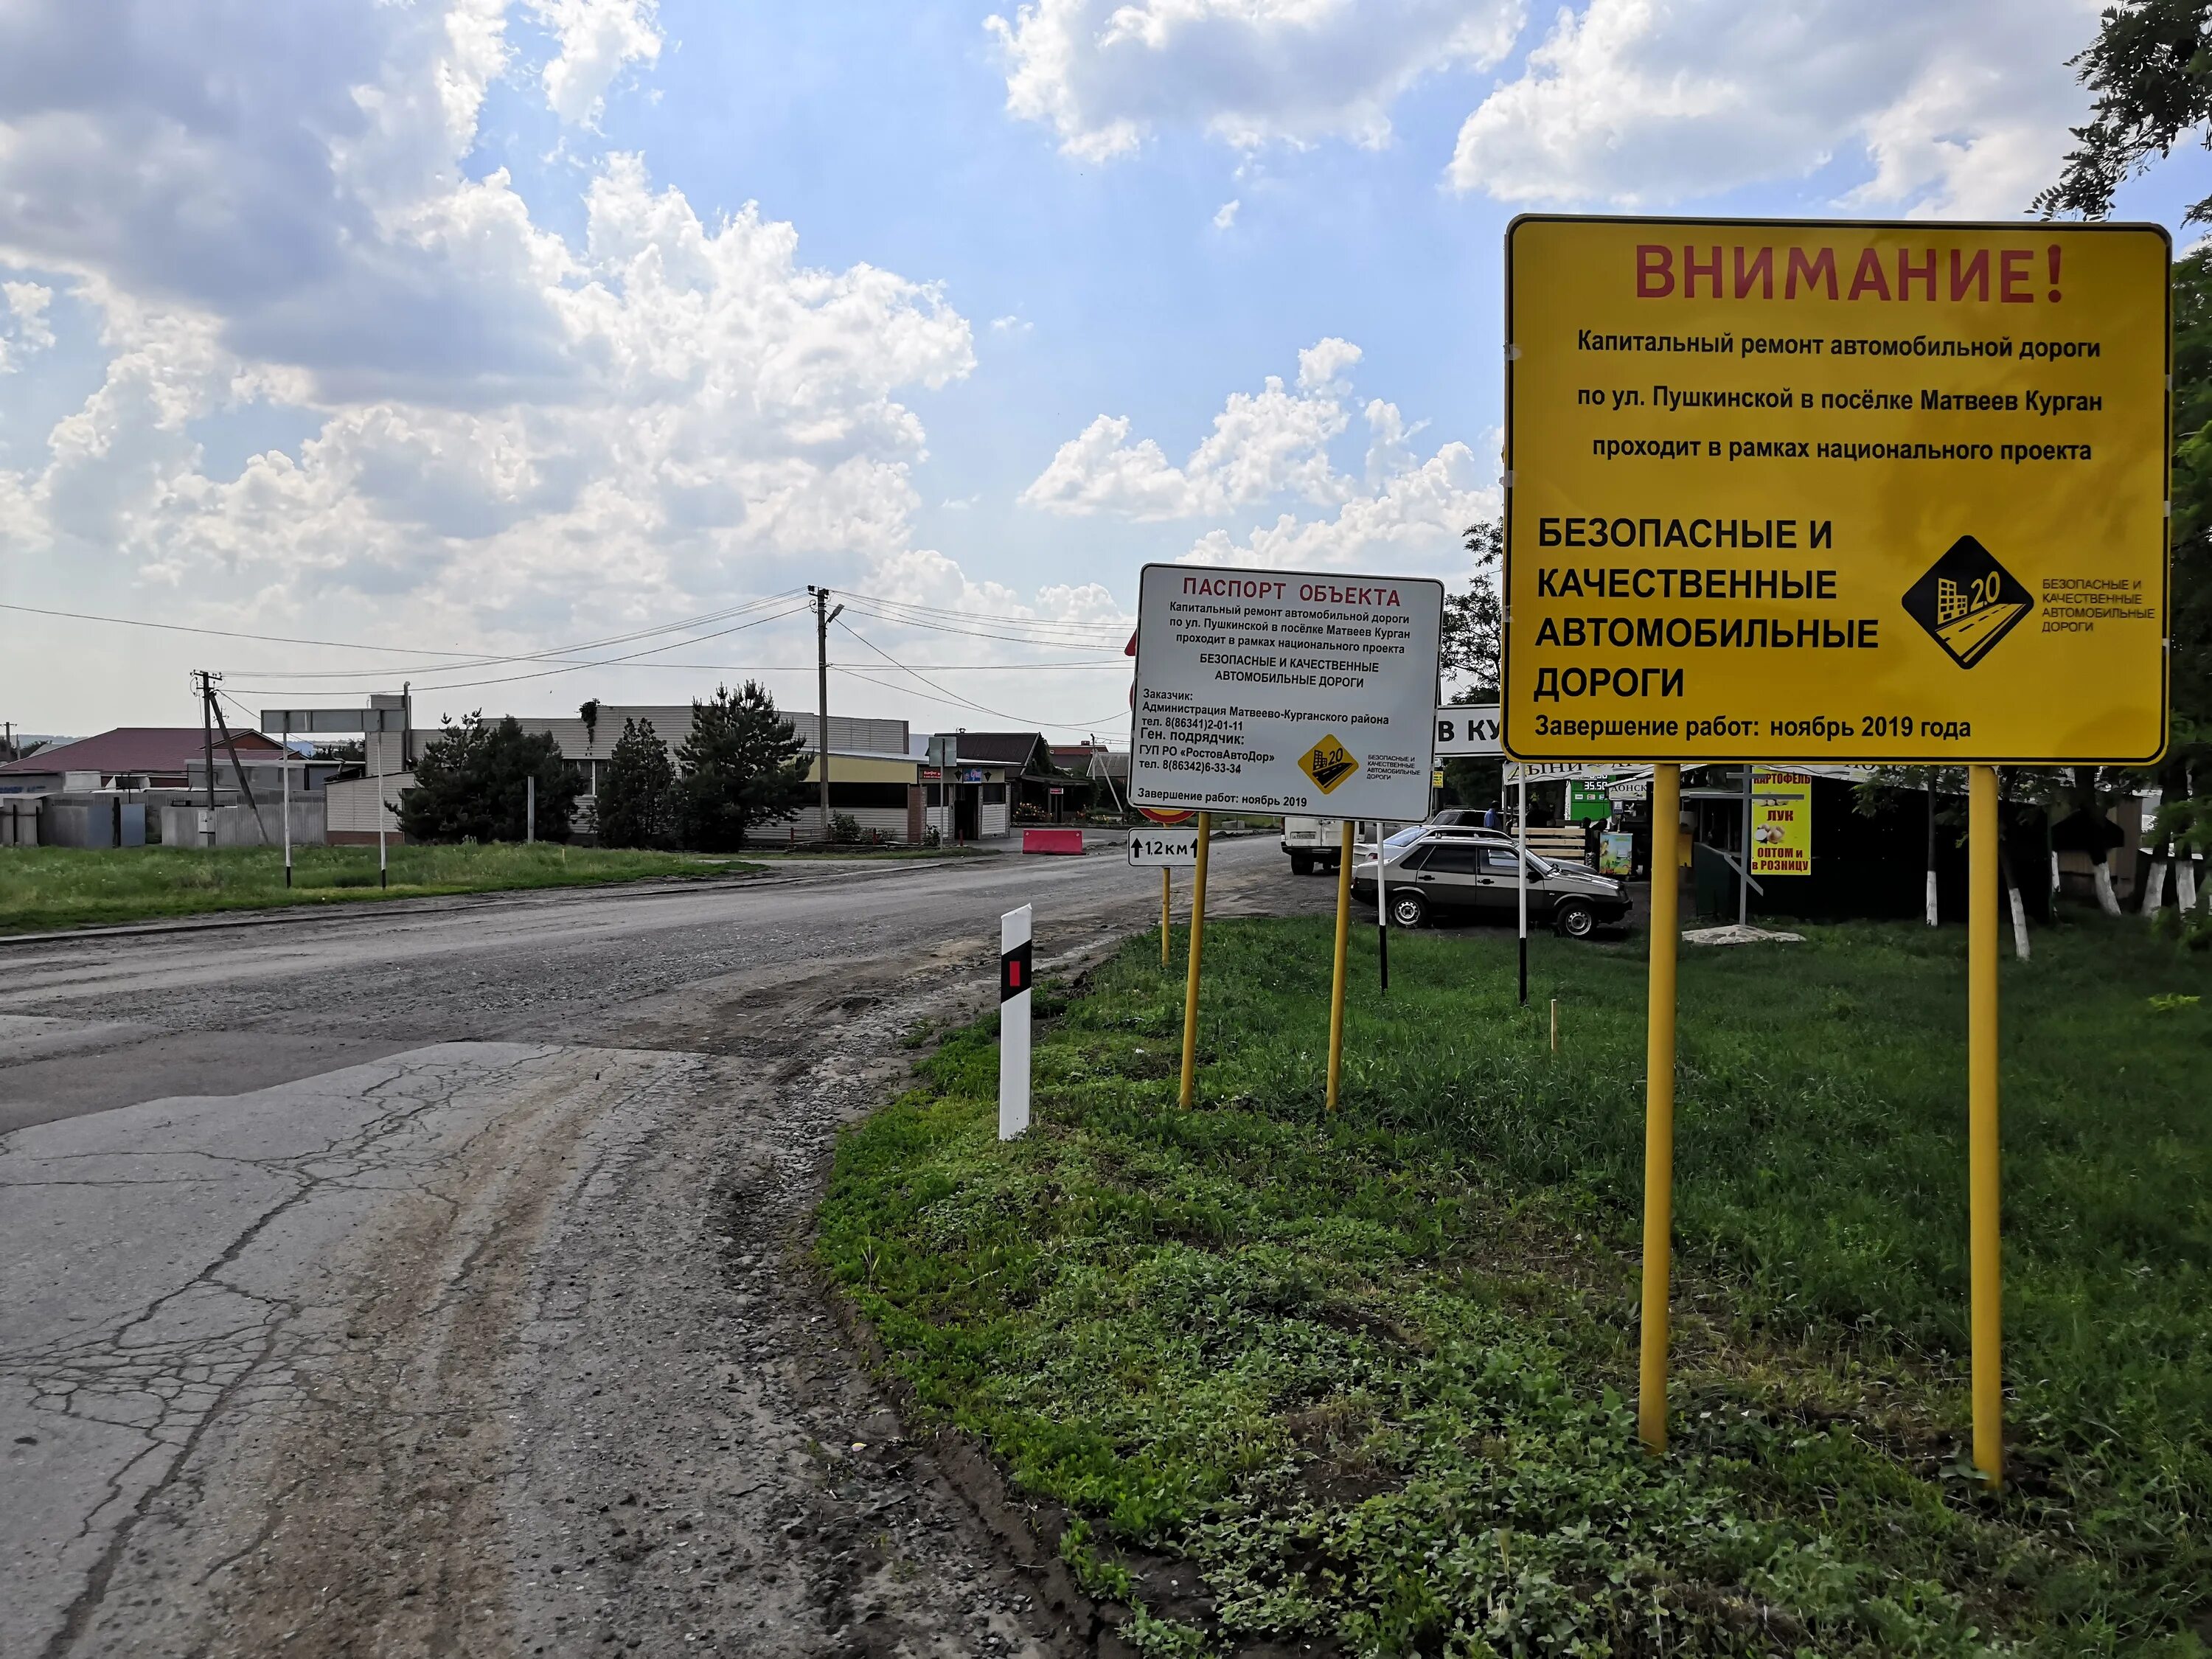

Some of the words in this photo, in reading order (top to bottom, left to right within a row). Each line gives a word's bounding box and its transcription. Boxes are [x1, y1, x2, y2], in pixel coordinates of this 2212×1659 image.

[1636, 243, 2062, 304] ВНИМАНИЕ!
[1578, 329, 1733, 353] Капитальный
[1742, 337, 1824, 359] ремонт
[1830, 335, 2012, 357] автомобильной
[2019, 341, 2101, 362] дороги
[1578, 389, 1605, 406] по
[1612, 389, 1645, 411] ул.
[1653, 385, 1793, 412] Пушкинской
[1801, 393, 1814, 408] в
[1821, 389, 1913, 410] посёлке
[1921, 389, 2018, 411] Матвеев
[2025, 389, 2102, 417] Курган
[1593, 439, 1702, 461] проходит
[1708, 441, 1722, 456] в
[1729, 441, 1809, 462] рамках
[1817, 442, 1993, 462] национального
[2000, 444, 2092, 465] проекта
[1539, 517, 1797, 549] БЕЗОПАСНЫЕ
[1809, 520, 1832, 549] И
[1183, 577, 1287, 599] ПАСПОРТ
[1299, 584, 1401, 607] ОБЪЕКТА
[1537, 568, 1837, 599] КАЧЕСТВЕННЫЕ
[1970, 571, 2000, 612] 2.0
[2042, 579, 2129, 590] БЕЗОПАСНЫЕ
[2134, 580, 2141, 590] И
[2042, 594, 2142, 604] КАЧЕСТВЕННЫЕ
[1169, 601, 1241, 615] Капитальный
[1244, 608, 1283, 618] ремонт
[1284, 609, 1369, 622] автомобильной
[1371, 614, 1410, 625] дороги
[2042, 608, 2155, 619] АВТОМОБИЛЬНЫЕ
[1169, 619, 1183, 627] по
[1185, 619, 1201, 630] ул.
[1203, 618, 1268, 631] Пушкинской
[1271, 624, 1278, 632] в
[1281, 623, 1324, 634] посёлке
[1326, 625, 1371, 637] Матвеев
[1374, 627, 1411, 640] Курган
[1534, 617, 1879, 648] АВТОМОБИЛЬНЫЕ
[2042, 622, 2094, 633] ДОРОГИ
[1176, 634, 1226, 645] проходит
[1228, 637, 1235, 645] в
[1237, 637, 1276, 647] рамках
[1278, 639, 1360, 652] национального
[1363, 644, 1405, 655] проекта
[1200, 653, 1276, 667] БЕЗОПАСНЫЕ
[1279, 657, 1287, 667] И
[1290, 658, 1380, 672] КАЧЕСТВЕННЫЕ
[1214, 670, 1317, 686] АВТОМОБИЛЬНЫЕ
[1318, 675, 1364, 688] ДОРОГИ
[1533, 667, 1683, 703] ДОРОГИ
[1143, 688, 1193, 701] Заказчик:
[1141, 700, 1226, 717] Администрация
[1229, 706, 1349, 723] Матвеево-Курганского
[1351, 714, 1389, 726] района
[1141, 717, 1162, 726] тел.
[1165, 717, 1242, 731] 8(86341)2-01-11
[1438, 720, 1455, 742] В
[1534, 714, 1678, 741] Завершение
[1686, 714, 1759, 741] работ:
[1770, 715, 1854, 742] ноябрь
[1861, 715, 1913, 737] 2019
[1921, 721, 1971, 741] года
[1140, 726, 1166, 740] Ген.
[1169, 731, 1245, 745] подрядчик:
[1139, 744, 1160, 756] ГУП
[1162, 745, 1178, 757] РО
[1180, 747, 1275, 764] «РостовАвтоДор»
[1138, 760, 1160, 769] тел.
[1163, 759, 1242, 774] 8(86342)6-33-34
[1137, 787, 1203, 801] Завершение
[1205, 792, 1239, 804] работ:
[1242, 795, 1281, 807] ноябрь
[1283, 796, 1307, 807] 2019
[1767, 810, 1793, 821] ЛУК
[1758, 848, 1793, 858] ОПТОМ
[1761, 860, 1808, 871] РОЗНИЦУ
